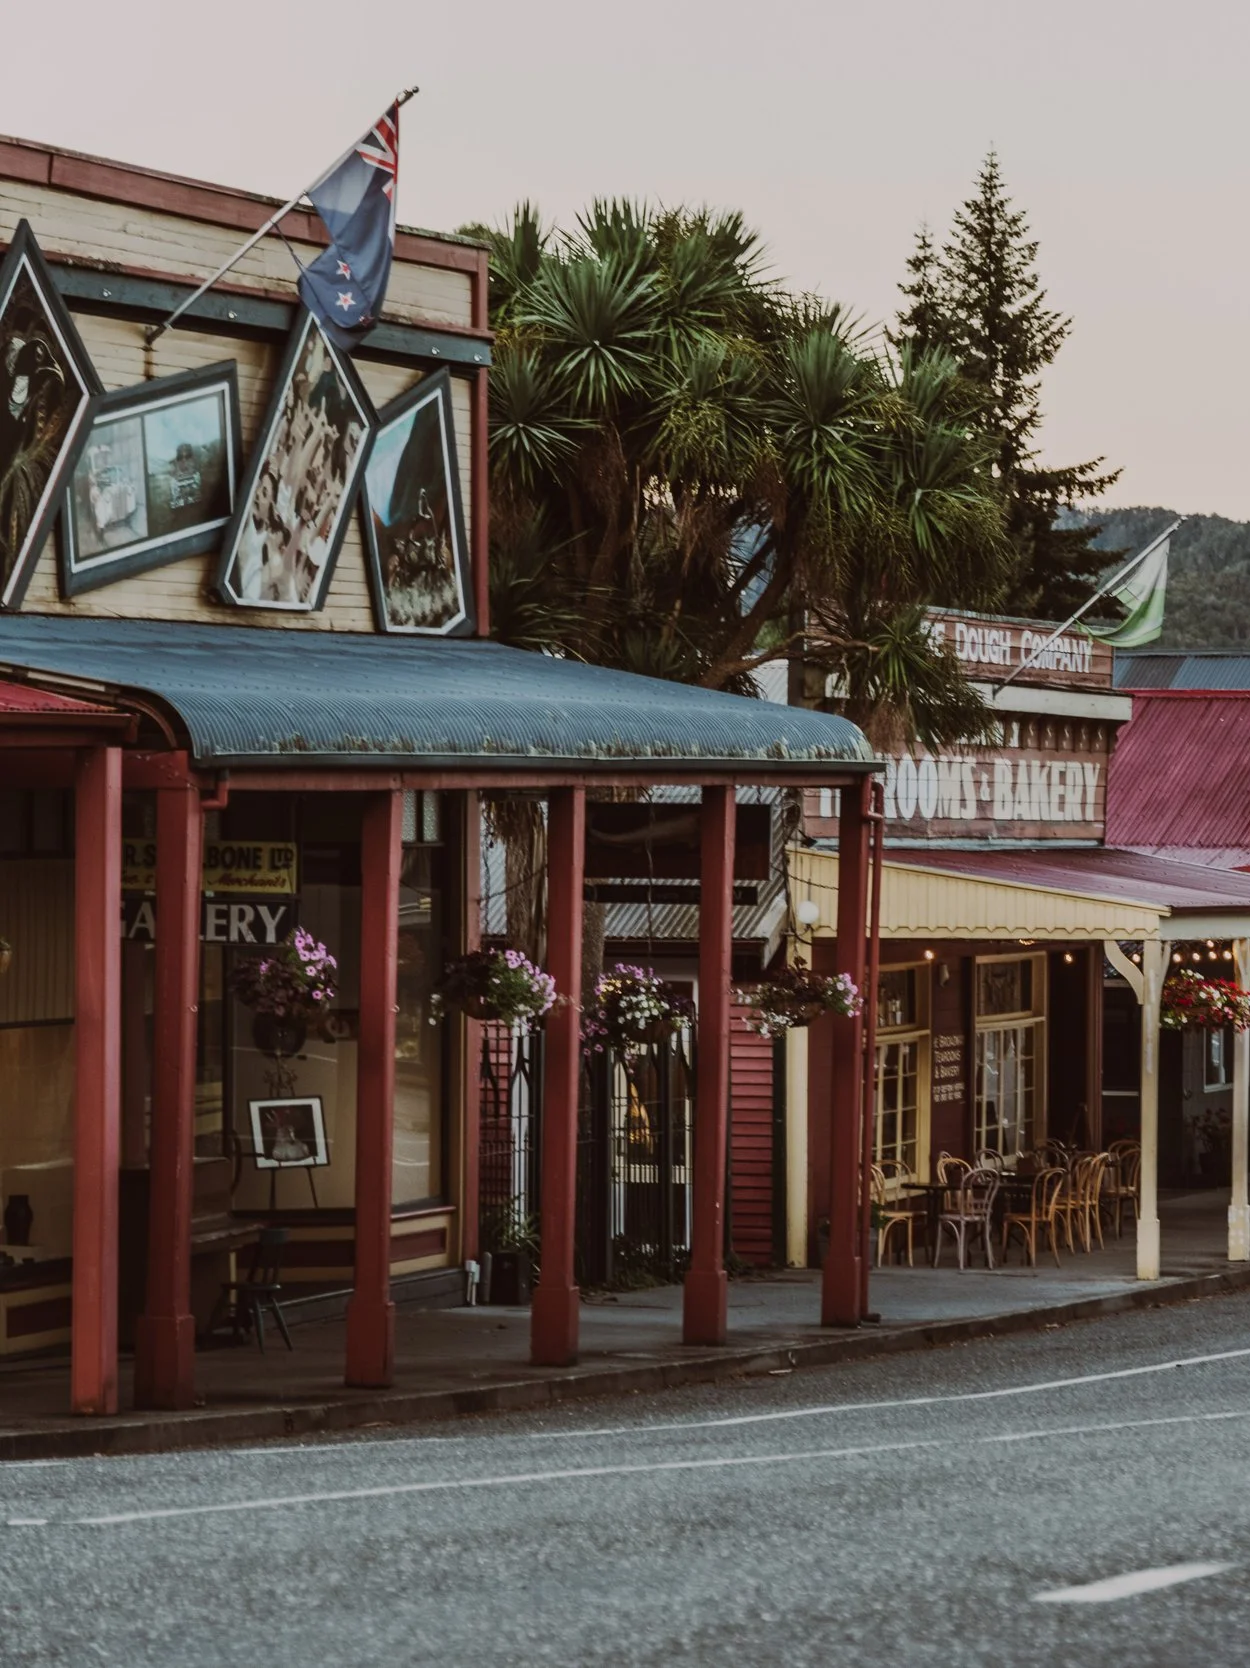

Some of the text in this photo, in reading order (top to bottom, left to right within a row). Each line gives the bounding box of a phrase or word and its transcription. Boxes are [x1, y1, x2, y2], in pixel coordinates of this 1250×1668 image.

[955, 623, 1012, 666] DOUGH
[1020, 630, 1094, 673] COMPANY
[979, 771, 991, 801] &
[993, 757, 1100, 821] BAKERY
[121, 901, 287, 944] AERY
